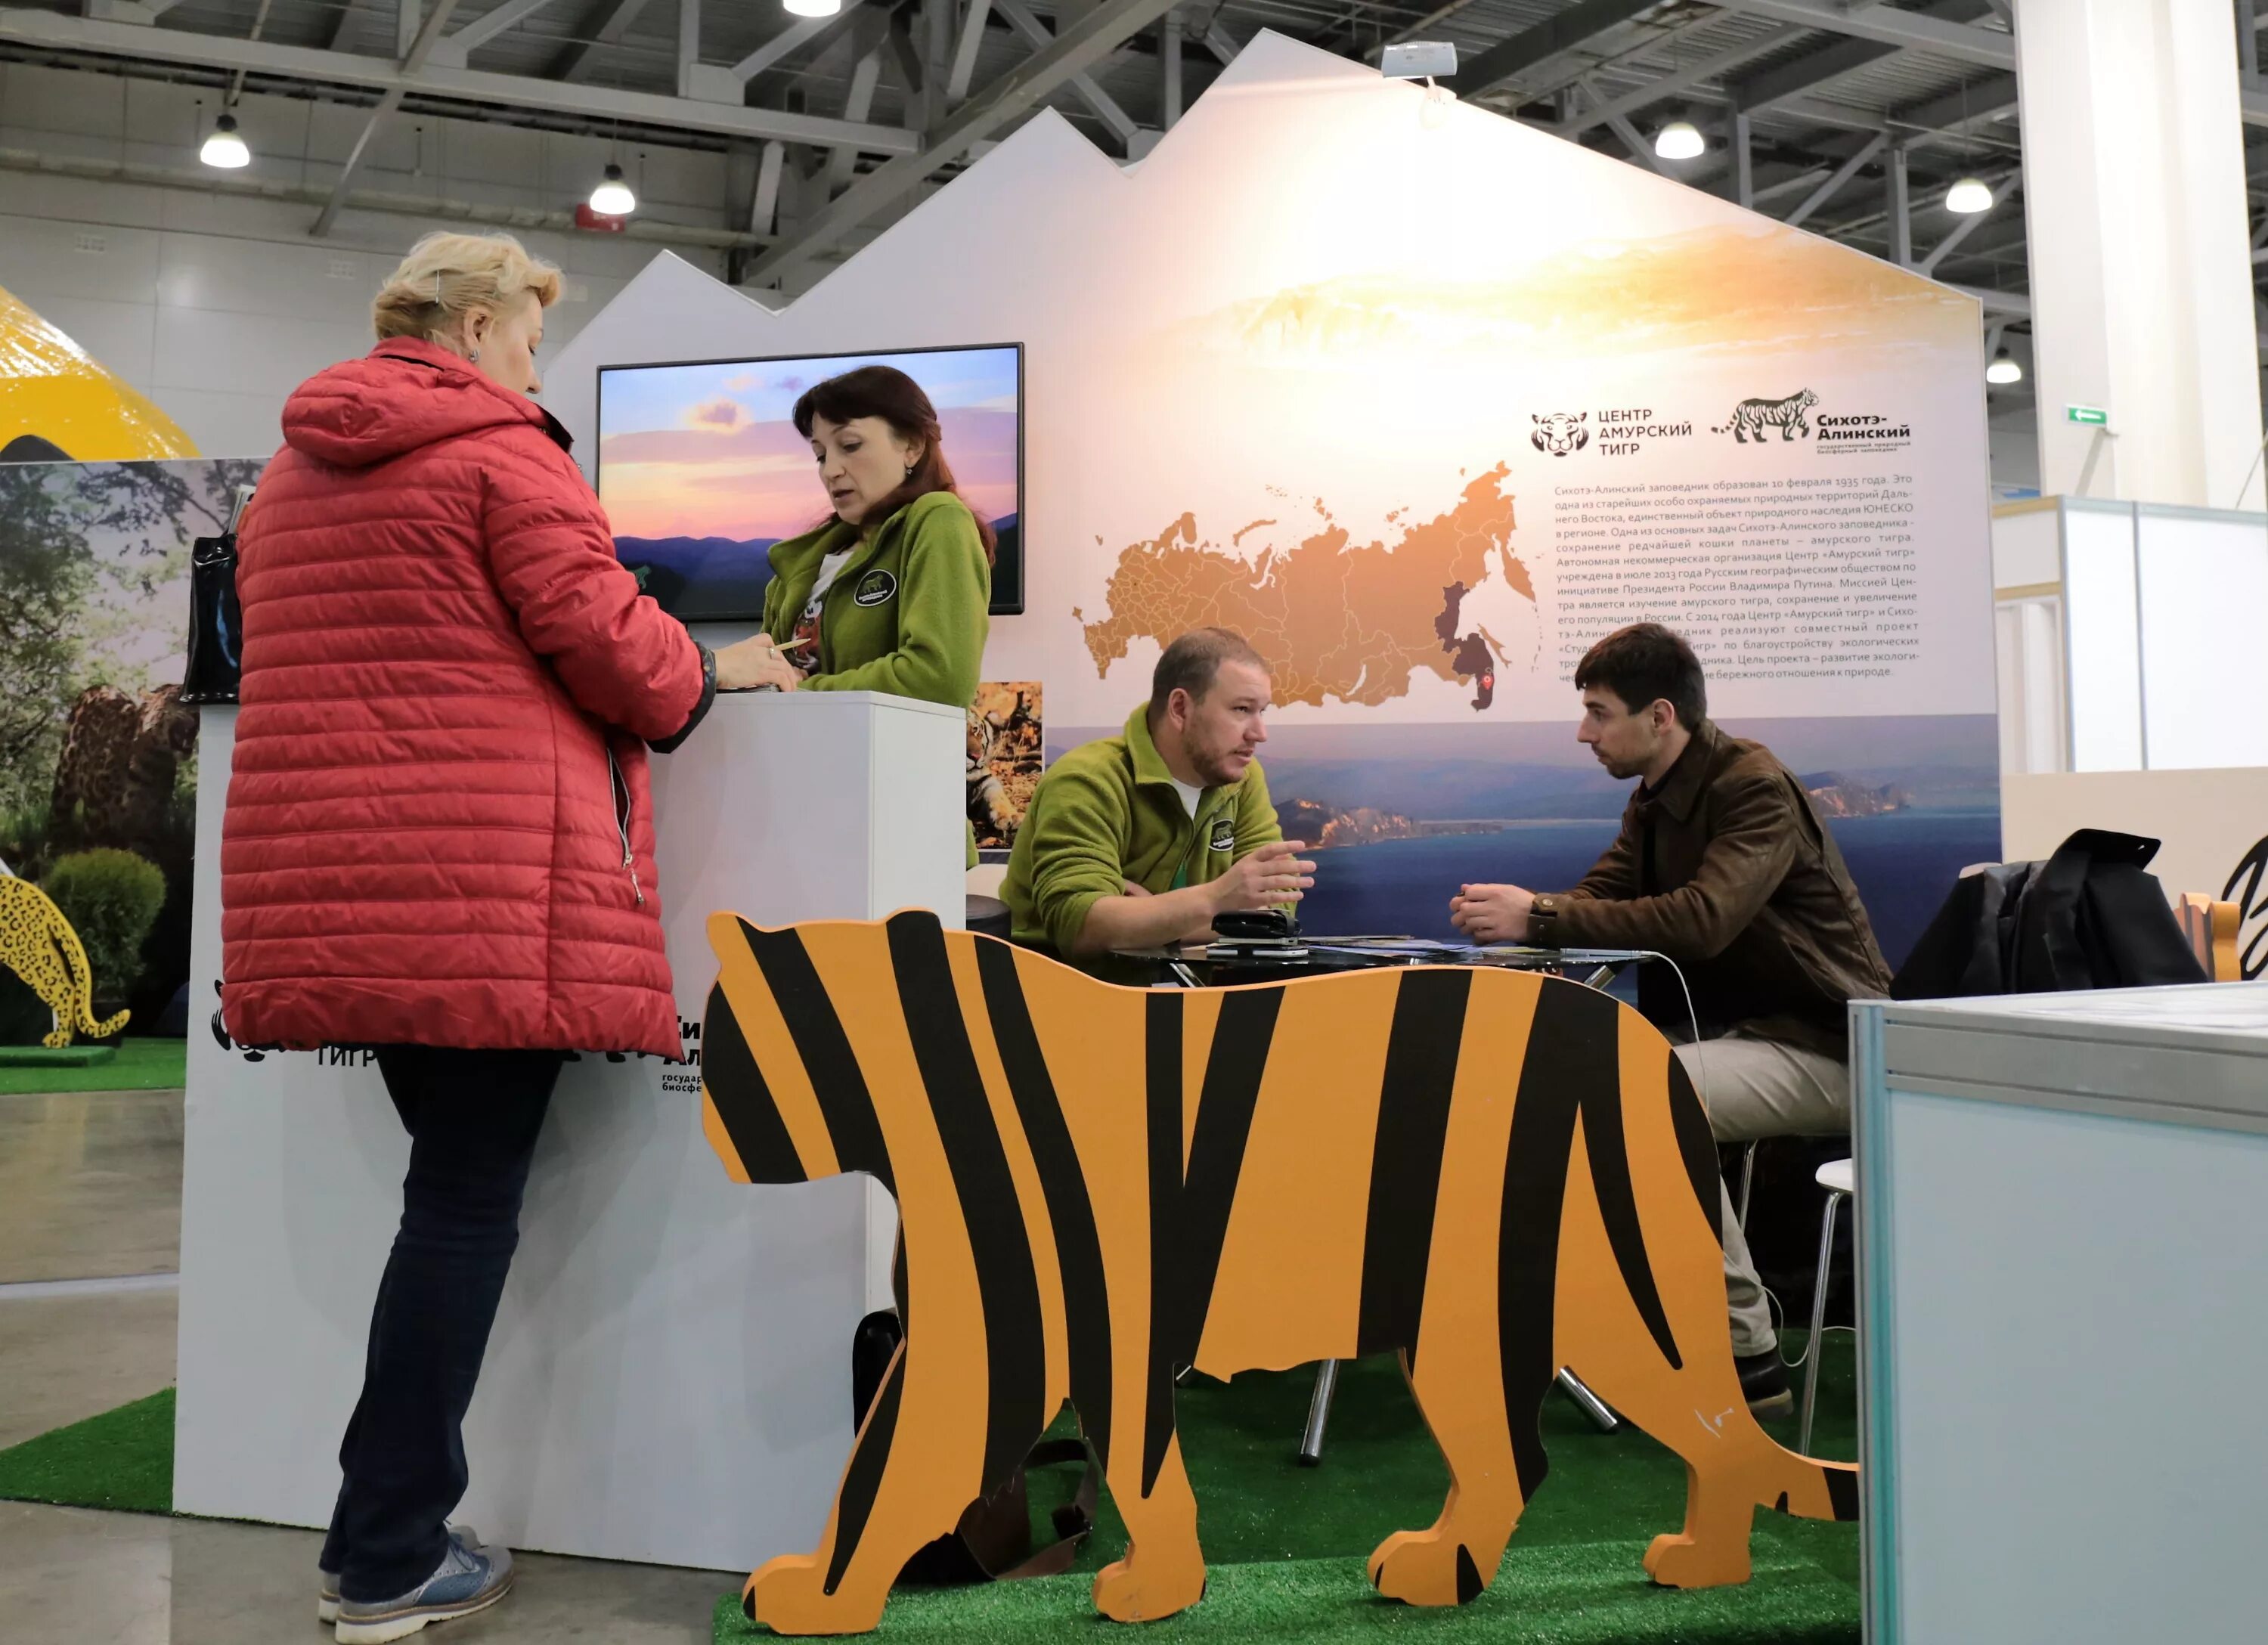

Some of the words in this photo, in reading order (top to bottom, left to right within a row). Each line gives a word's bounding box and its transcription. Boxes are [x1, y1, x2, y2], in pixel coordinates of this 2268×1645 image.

[1598, 409, 1653, 423] ЦЕНТР
[1817, 414, 1888, 426] Сихотэ-
[1599, 420, 1692, 439] АМУРСКИЙ
[1817, 424, 1910, 441] Алинский
[1599, 443, 1641, 456] ТИГР
[1554, 482, 1645, 496] Сихотэ-Алинский
[1648, 484, 1709, 494] заповедник
[1712, 480, 1768, 493] образован
[1786, 478, 1833, 491] февраля
[1836, 479, 1859, 489] 1935
[1893, 474, 1913, 485] Это
[1554, 501, 1580, 511] одна
[1596, 496, 1652, 510] старейших
[1653, 495, 1685, 506] особо
[1687, 496, 1752, 507] охраняемых
[1754, 494, 1813, 505] природных
[1816, 488, 1879, 503] территорий
[1628, 507, 1704, 523] единственный
[1706, 508, 1742, 519] объект
[1744, 508, 1808, 520] природного
[1810, 507, 1861, 516] наследия
[1864, 501, 1914, 513] ЮНЕСКО
[1610, 525, 1638, 537] Одна
[1654, 526, 1704, 534] основных
[1706, 525, 1737, 534] задач
[1738, 520, 1837, 531] Сихотэ-Алинского
[1839, 519, 1908, 529] заповедника
[1556, 543, 1621, 554] сохранение
[1628, 537, 1691, 553] редчайшей
[1742, 537, 1789, 546] планеты
[1811, 535, 1871, 547] амурского
[1556, 556, 1620, 566] Автономная
[1623, 555, 1710, 566] некоммерческая
[1713, 553, 1782, 564] организация
[1785, 549, 1819, 562] Центр
[1557, 572, 1613, 583] учреждена
[1653, 570, 1676, 579] 2013
[1678, 569, 1703, 578] года
[1704, 565, 1748, 579] Русским
[1750, 563, 1838, 578] географическим
[1840, 562, 1901, 575] обществом
[1557, 587, 1619, 596] инициативе
[1622, 584, 1685, 596] Президента
[1689, 582, 1726, 592] России
[1730, 581, 1790, 593] Владимира
[1839, 577, 1887, 588] Миссией
[1557, 602, 1575, 612] тра
[1579, 601, 1625, 609] является
[1628, 599, 1677, 610] изучение
[1681, 598, 1736, 609] амурского
[1777, 595, 1839, 606] сохранение
[1854, 593, 1917, 605] увеличение
[1577, 615, 1634, 626] популяции
[1686, 611, 1693, 621] С
[1695, 613, 1719, 623] 2014
[1721, 612, 1746, 621] года
[1748, 609, 1781, 621] Центр
[1721, 626, 1786, 637] реализуют
[1794, 621, 1868, 633] совместный
[1876, 623, 1919, 634] проект
[1743, 637, 1833, 651] благоустройству
[1839, 637, 1919, 646] экологических
[1737, 653, 1765, 666] Цель
[1767, 655, 1810, 666] проекта
[1820, 654, 1870, 665] развитие
[1716, 668, 1774, 681] бережного
[1775, 669, 1836, 677] отношения
[662, 1083, 702, 1094] биосфе
